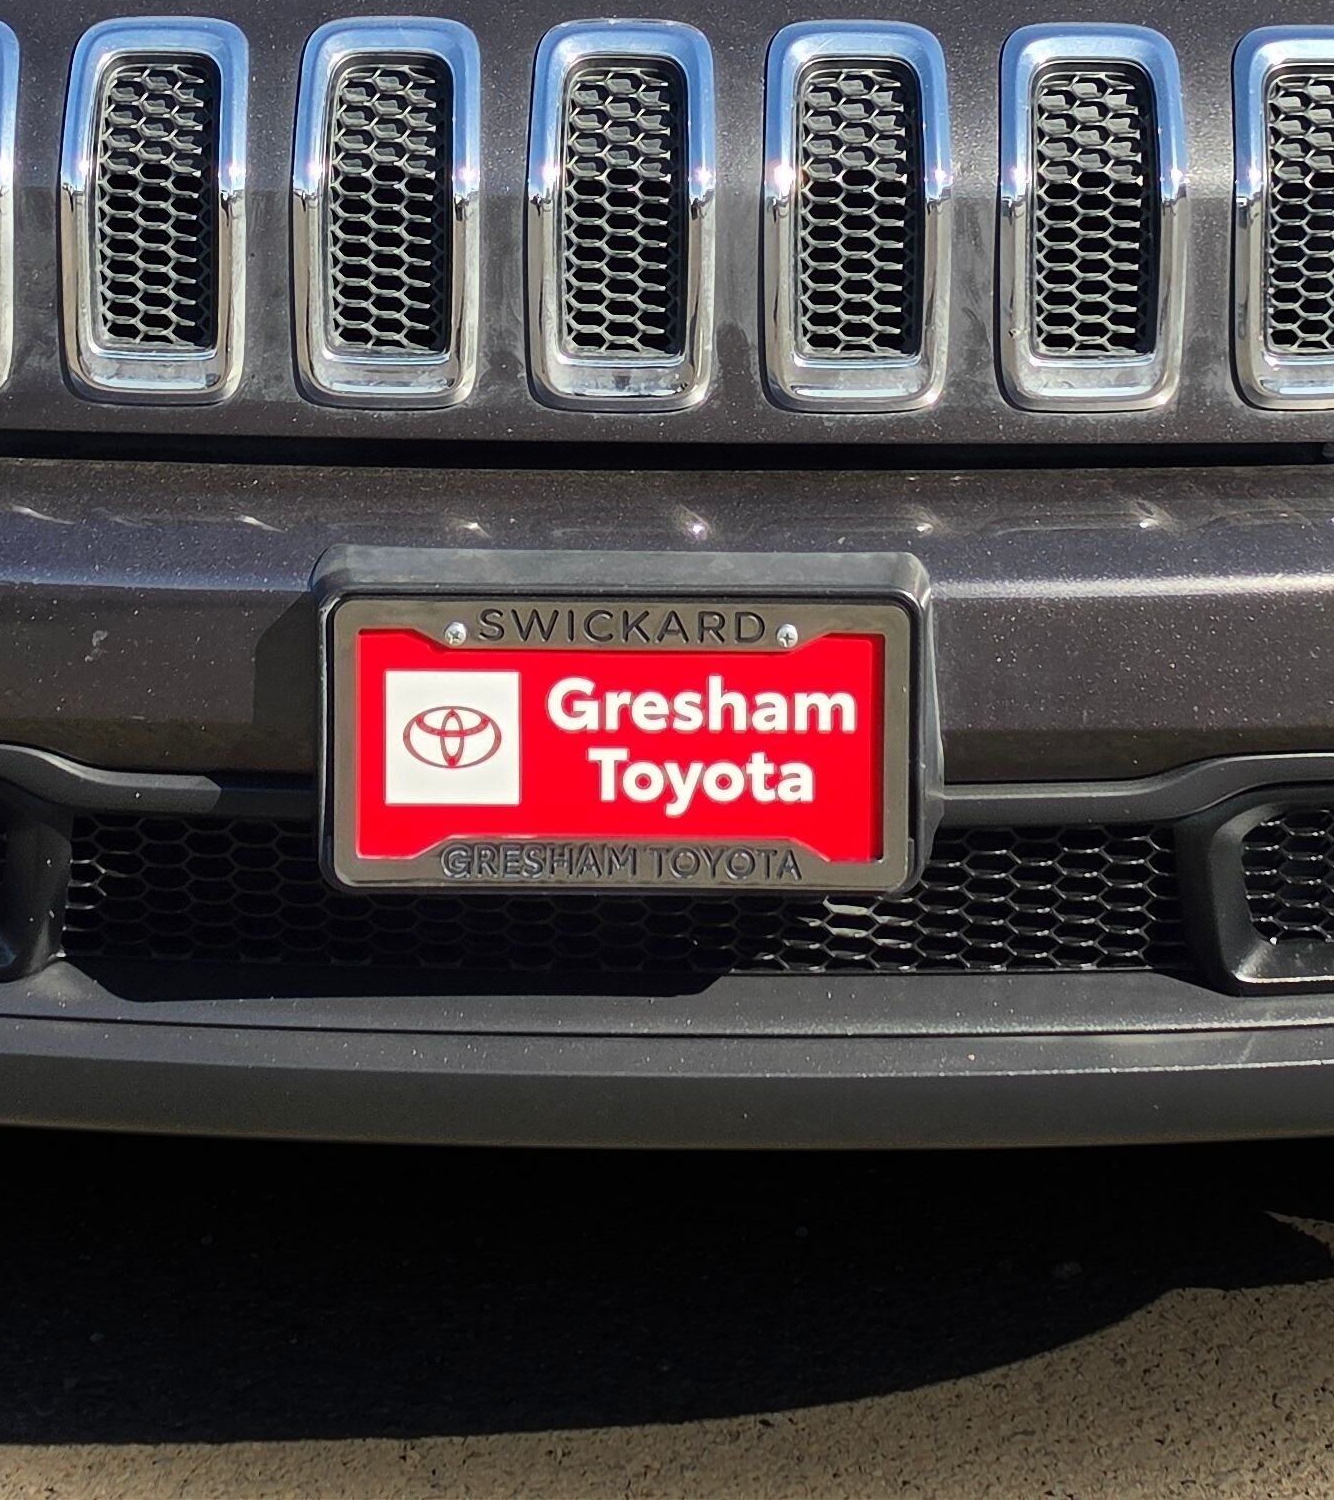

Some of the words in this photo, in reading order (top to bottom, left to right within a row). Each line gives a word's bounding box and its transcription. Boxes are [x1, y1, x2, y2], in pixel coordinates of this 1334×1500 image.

[478, 608, 766, 645] SWICKARD
[546, 674, 857, 734] Gresham
[587, 747, 815, 818] Toyota
[439, 843, 637, 880] GRESHAM
[646, 845, 803, 882] TOYOTA
